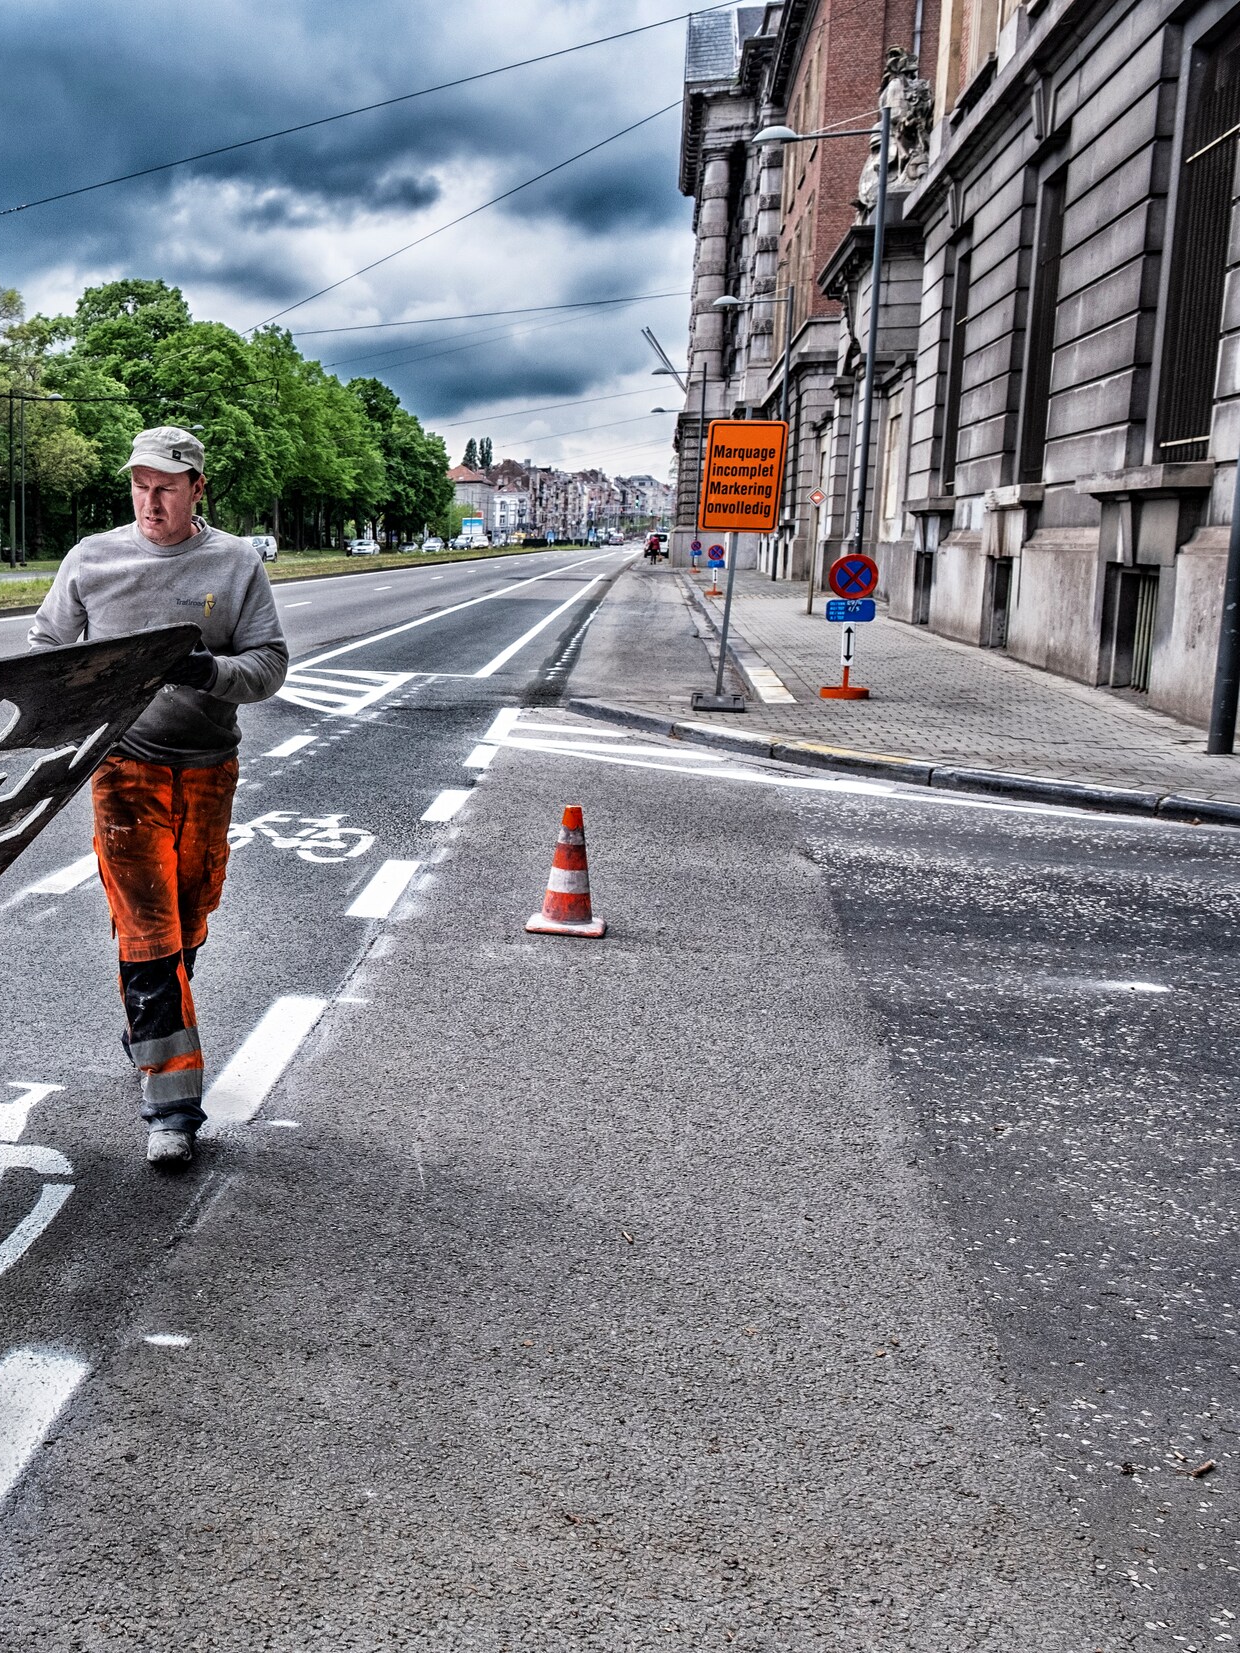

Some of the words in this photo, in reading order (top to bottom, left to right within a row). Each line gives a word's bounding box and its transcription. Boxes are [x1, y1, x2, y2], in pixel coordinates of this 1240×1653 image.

[714, 445, 776, 461] Marquage
[712, 463, 774, 479] incomplet
[709, 481, 772, 498] Markering
[707, 501, 771, 518] onvolledig
